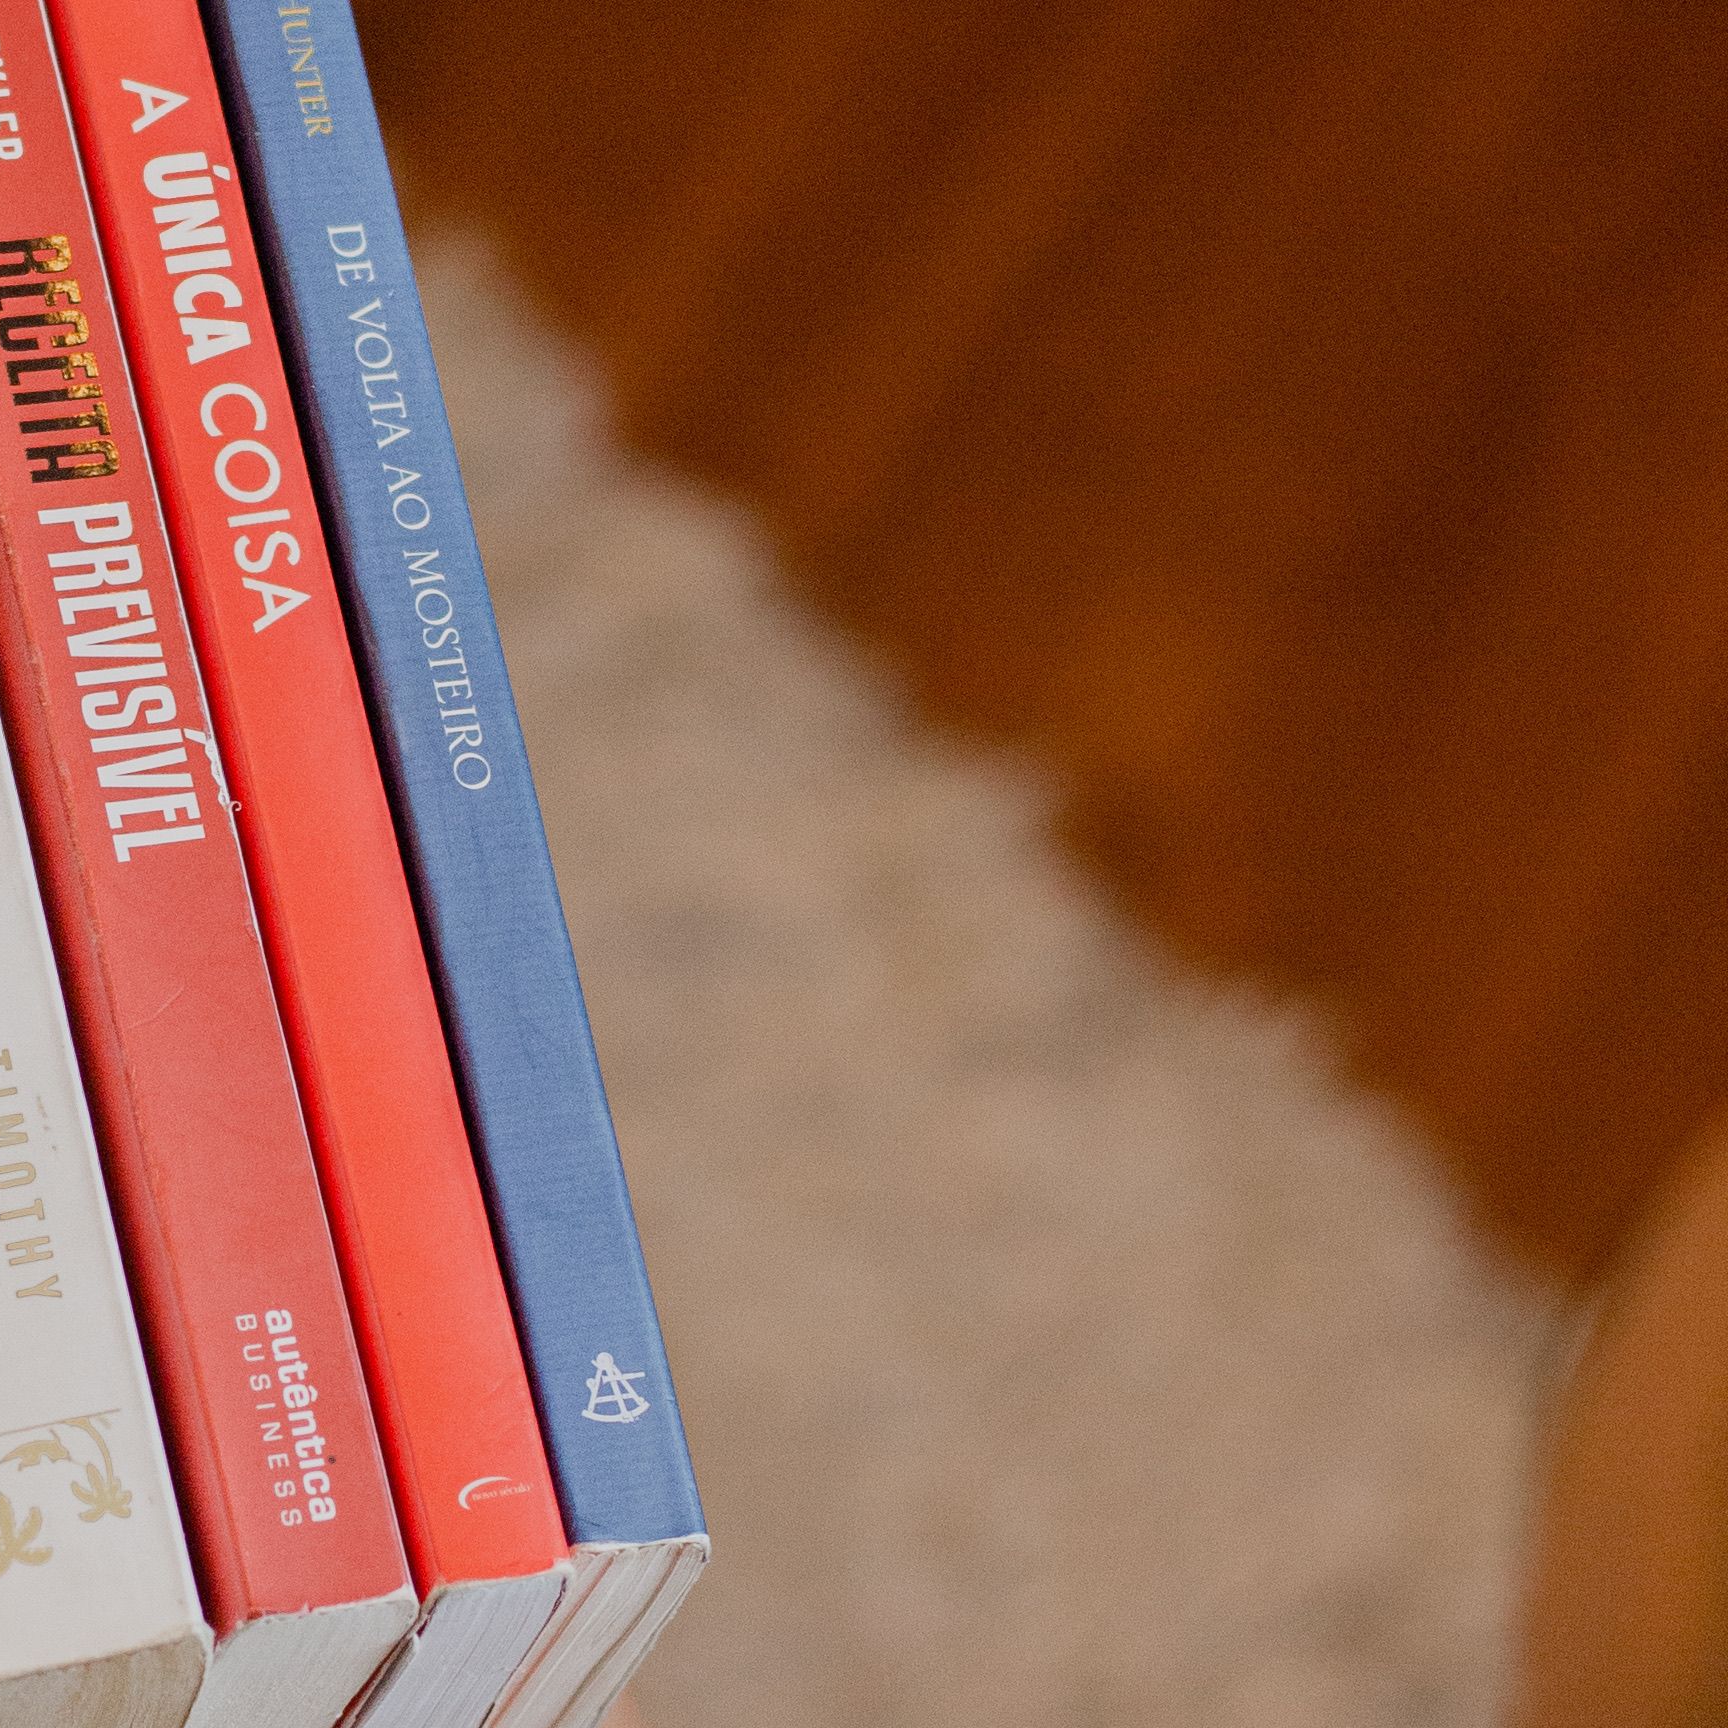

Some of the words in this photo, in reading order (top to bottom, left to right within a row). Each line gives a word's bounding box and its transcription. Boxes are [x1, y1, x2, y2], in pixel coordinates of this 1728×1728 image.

[121, 78, 189, 134] A
[143, 151, 251, 364] ÚNICA
[327, 223, 374, 287] DE
[347, 298, 411, 449] VOLTA
[200, 382, 311, 633] COISA
[382, 461, 430, 531] AO
[37, 501, 210, 863] PREVISÍVEL
[403, 548, 491, 790] MOSTEIRO
[235, 1313, 302, 1528] BUSINESS
[264, 1308, 337, 1523] autêntica
